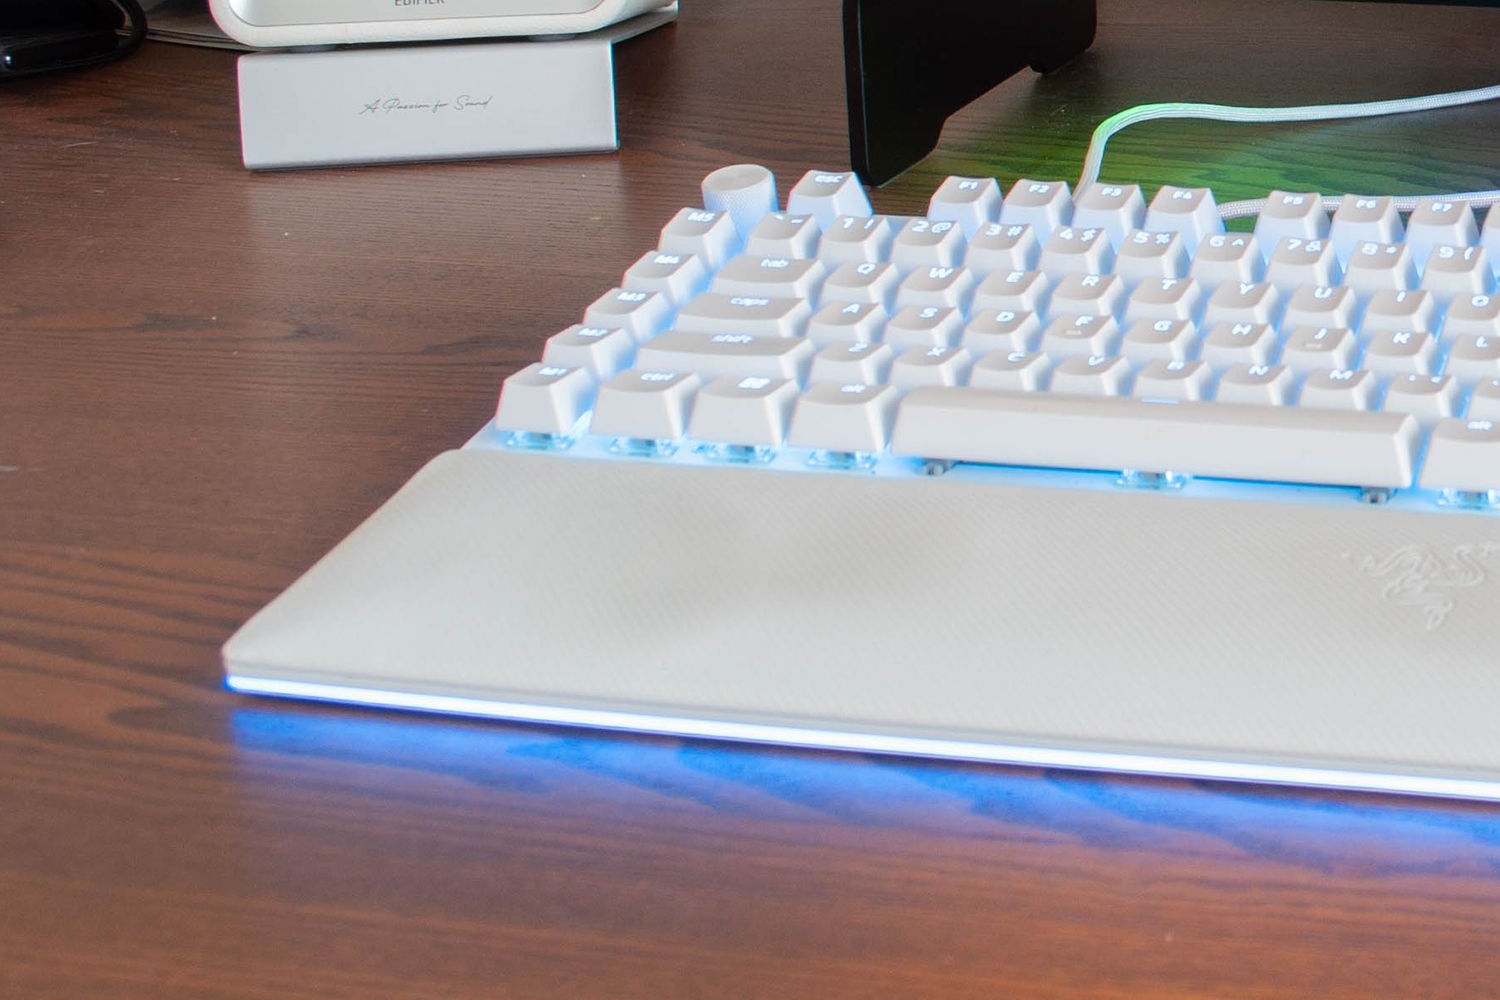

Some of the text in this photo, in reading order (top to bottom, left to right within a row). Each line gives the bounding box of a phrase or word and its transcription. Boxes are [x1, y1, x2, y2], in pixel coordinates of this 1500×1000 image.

[814, 175, 842, 183] esc
[958, 181, 979, 190] F1
[1029, 184, 1049, 193] F2
[1101, 187, 1122, 197] F3
[1172, 190, 1192, 199] F4
[1283, 196, 1303, 205] F5
[1356, 200, 1376, 208] F6
[1432, 203, 1452, 212] F7
[912, 221, 929, 232] 2
[984, 225, 1001, 236] 3
[1059, 228, 1073, 239] 4
[1133, 232, 1149, 243] 5
[761, 258, 789, 268] tab
